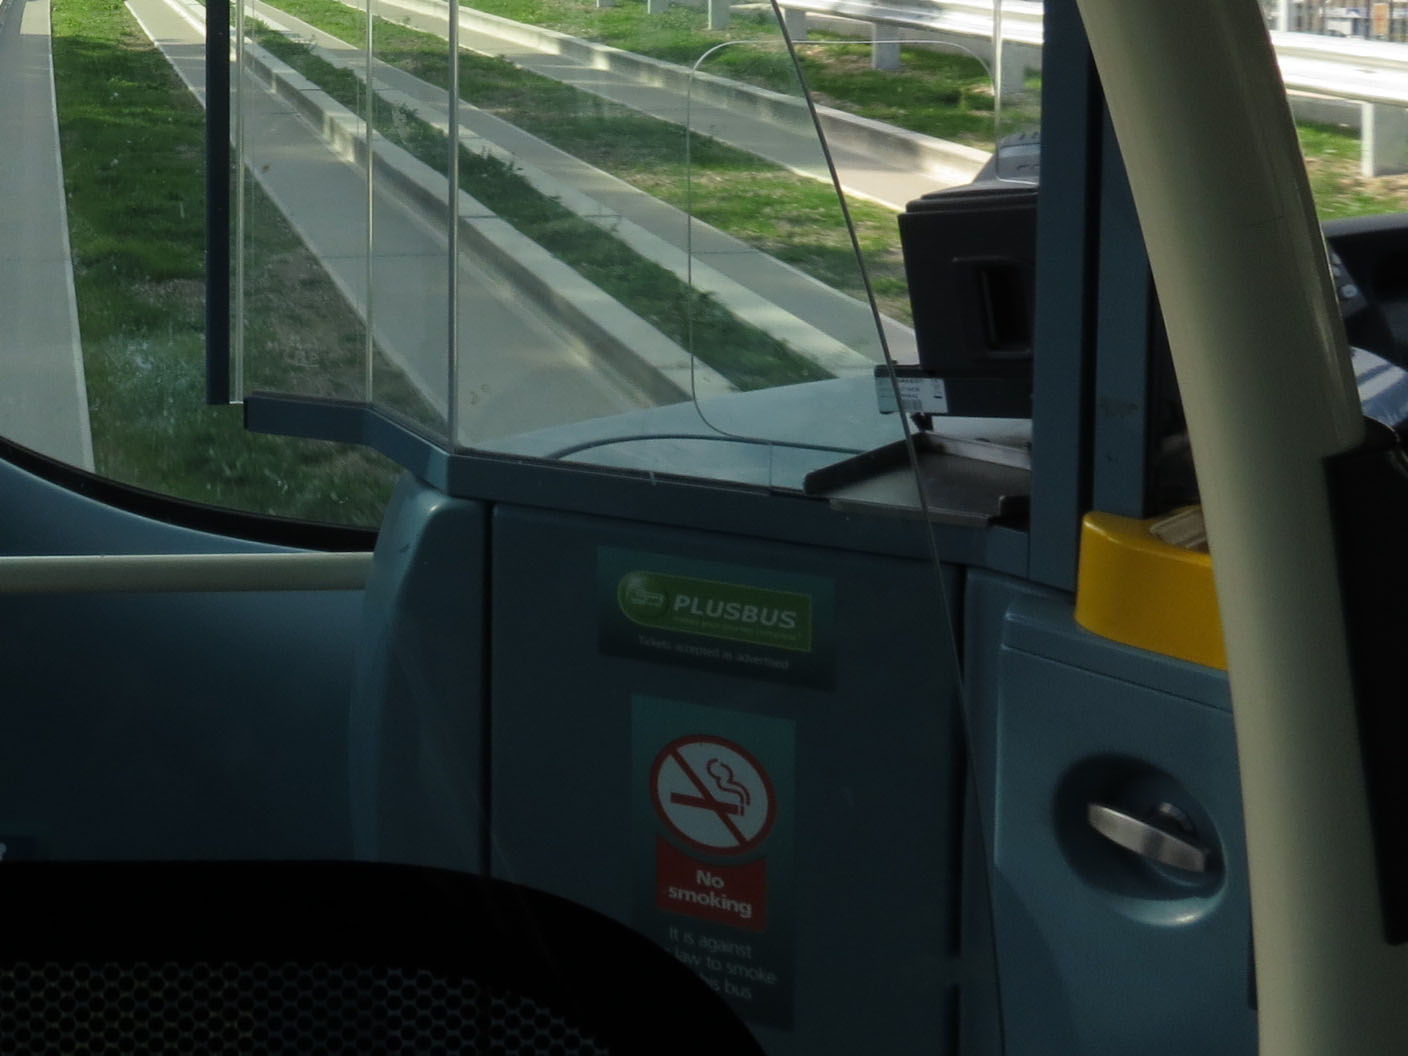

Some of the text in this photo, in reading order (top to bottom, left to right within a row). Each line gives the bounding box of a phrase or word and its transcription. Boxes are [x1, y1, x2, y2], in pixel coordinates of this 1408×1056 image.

[673, 594, 797, 629] PLUSBUS
[696, 870, 724, 888] No
[668, 886, 752, 918] smoking
[669, 927, 752, 959] It is against
[706, 957, 722, 971] to
[727, 963, 777, 984] smoke
[725, 979, 752, 1000] bus
